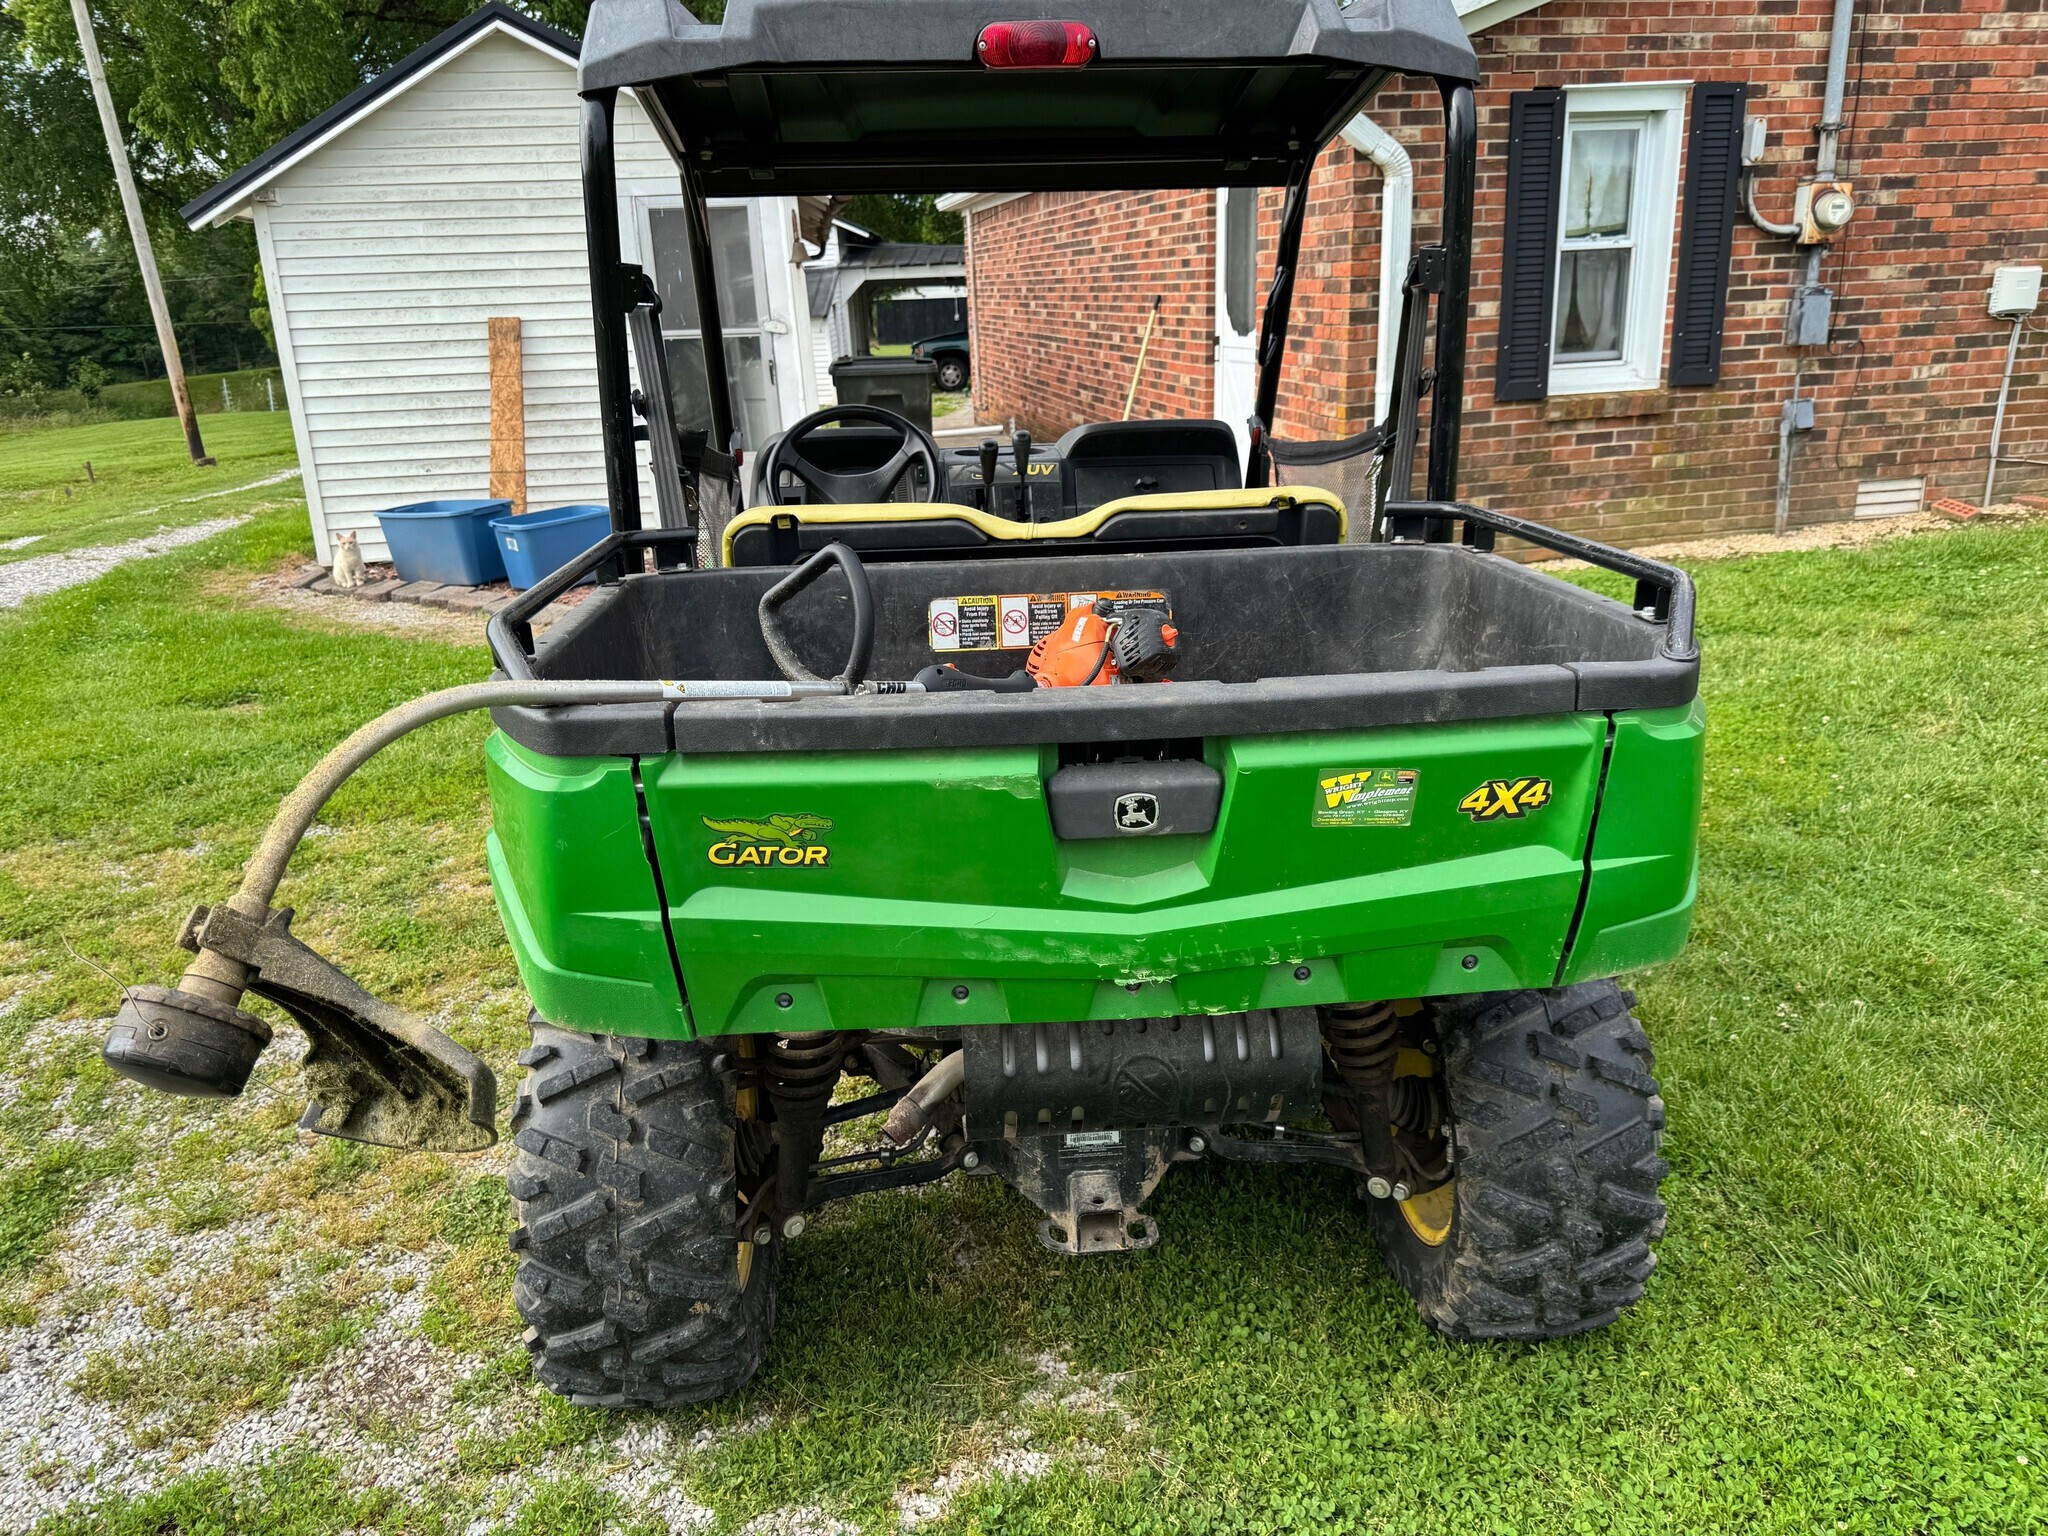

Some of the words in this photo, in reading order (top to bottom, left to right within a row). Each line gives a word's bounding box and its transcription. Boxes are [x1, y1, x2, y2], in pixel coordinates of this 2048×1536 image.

[1037, 594, 1065, 602] WNING
[877, 682, 907, 695] CHO
[1324, 782, 1364, 795] WRIGHT
[1348, 786, 1413, 803] Implement
[1460, 780, 1547, 816] 4X4
[708, 842, 828, 865] GATOR
